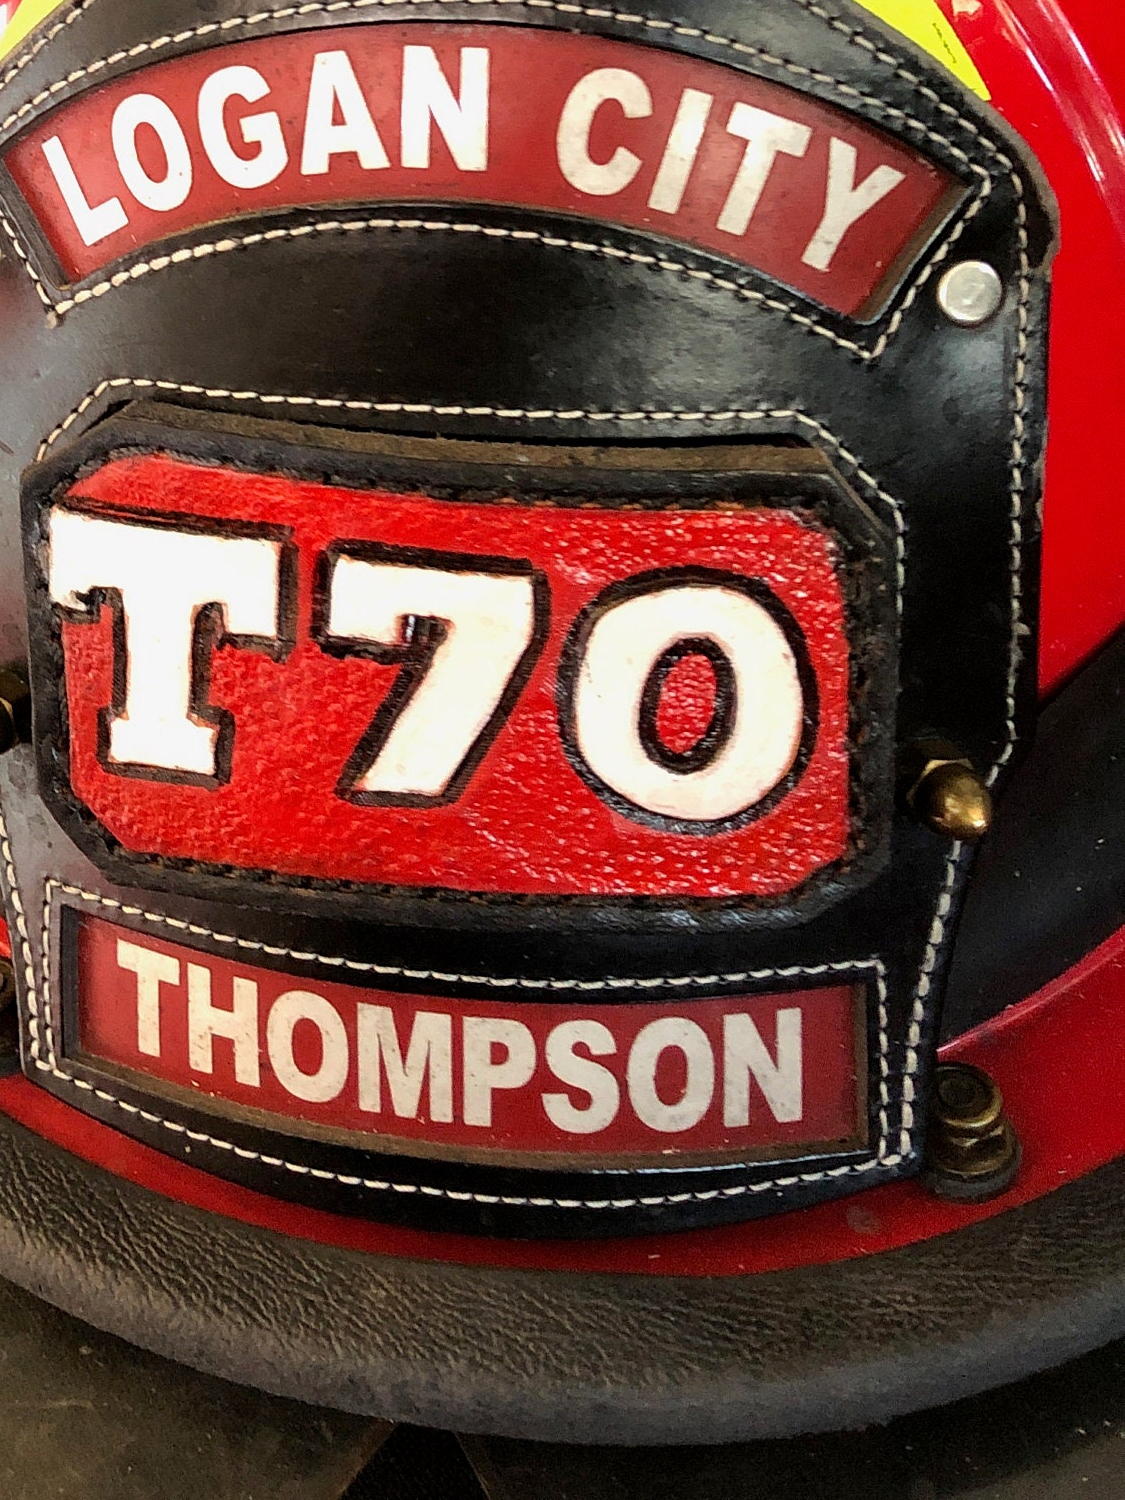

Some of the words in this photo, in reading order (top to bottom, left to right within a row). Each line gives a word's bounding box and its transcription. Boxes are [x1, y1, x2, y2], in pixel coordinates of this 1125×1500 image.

[42, 46, 491, 248] LOGAN
[556, 67, 907, 273] CITY
[116, 940, 803, 1134] THOMPSON
